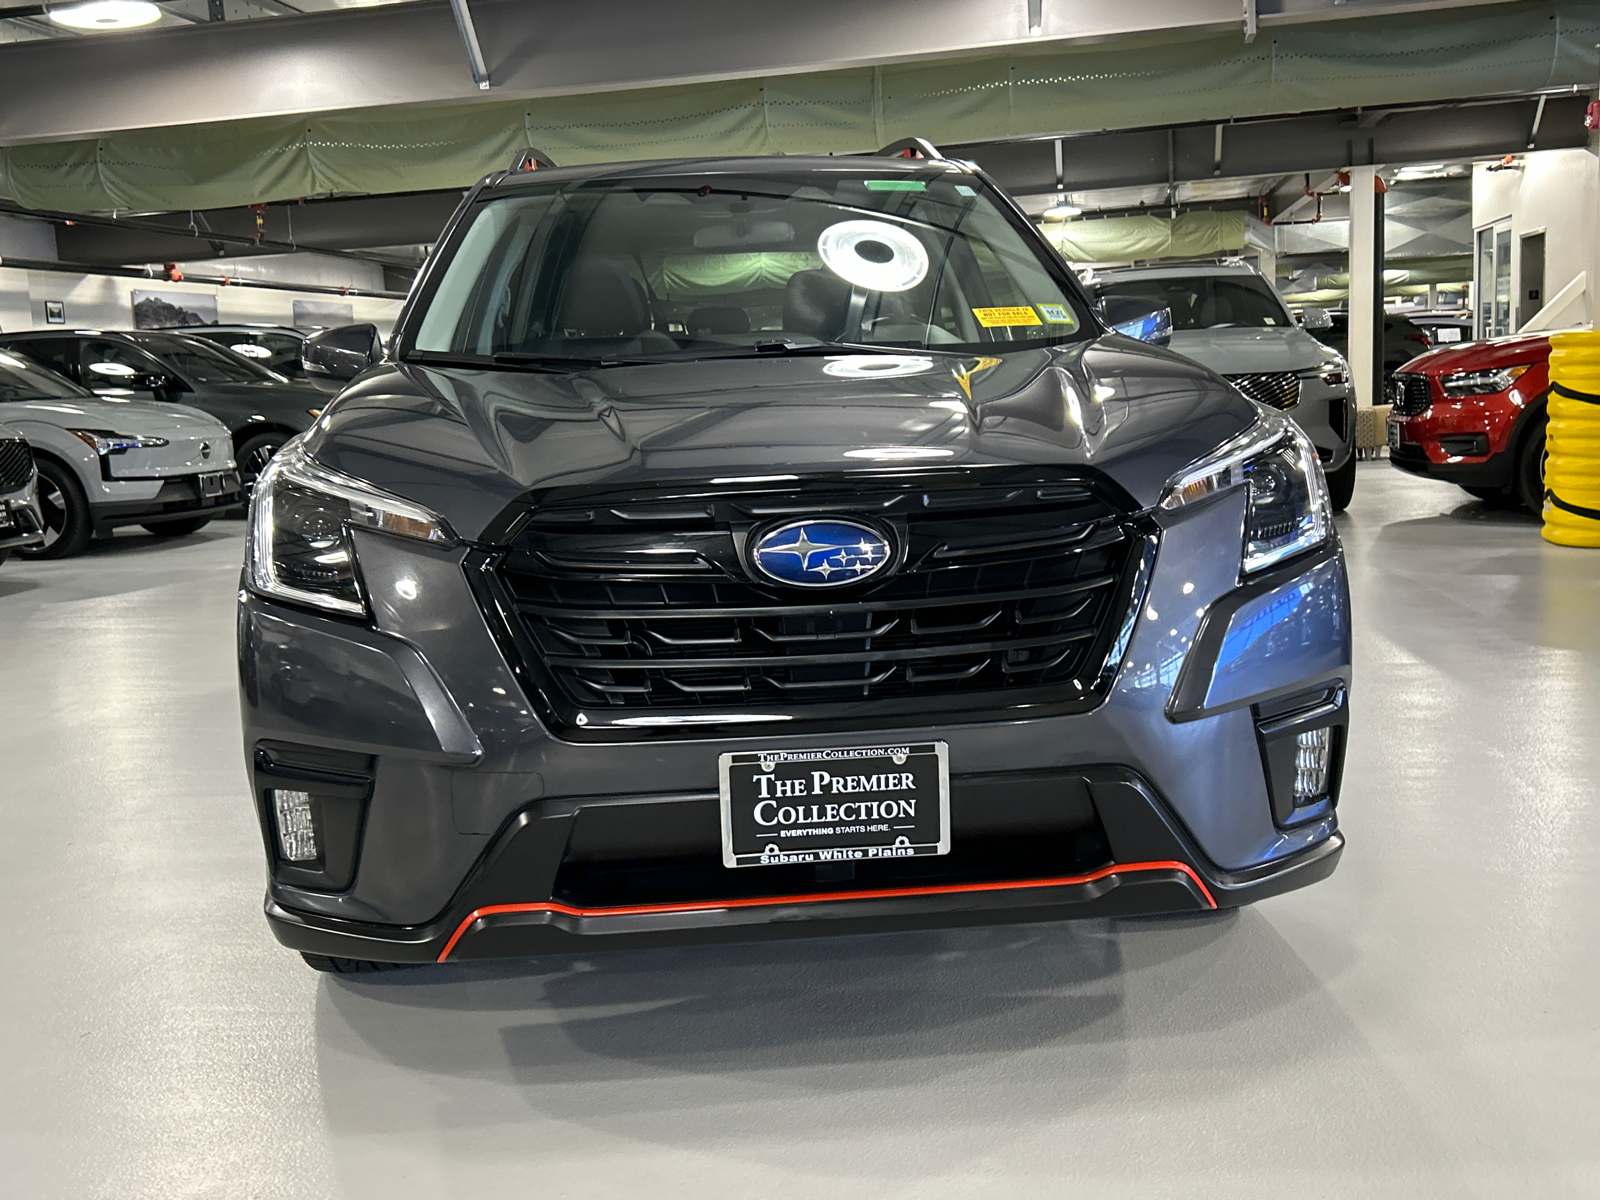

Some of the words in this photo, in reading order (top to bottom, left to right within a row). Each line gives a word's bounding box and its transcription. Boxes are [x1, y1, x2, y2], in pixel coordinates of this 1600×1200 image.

[780, 827, 834, 837] EVERYTHING
[835, 825, 866, 834] STARTS
[866, 824, 891, 832] HERE.
[760, 853, 814, 864] Subaru
[819, 849, 863, 860] White
[868, 847, 915, 857] Plains
